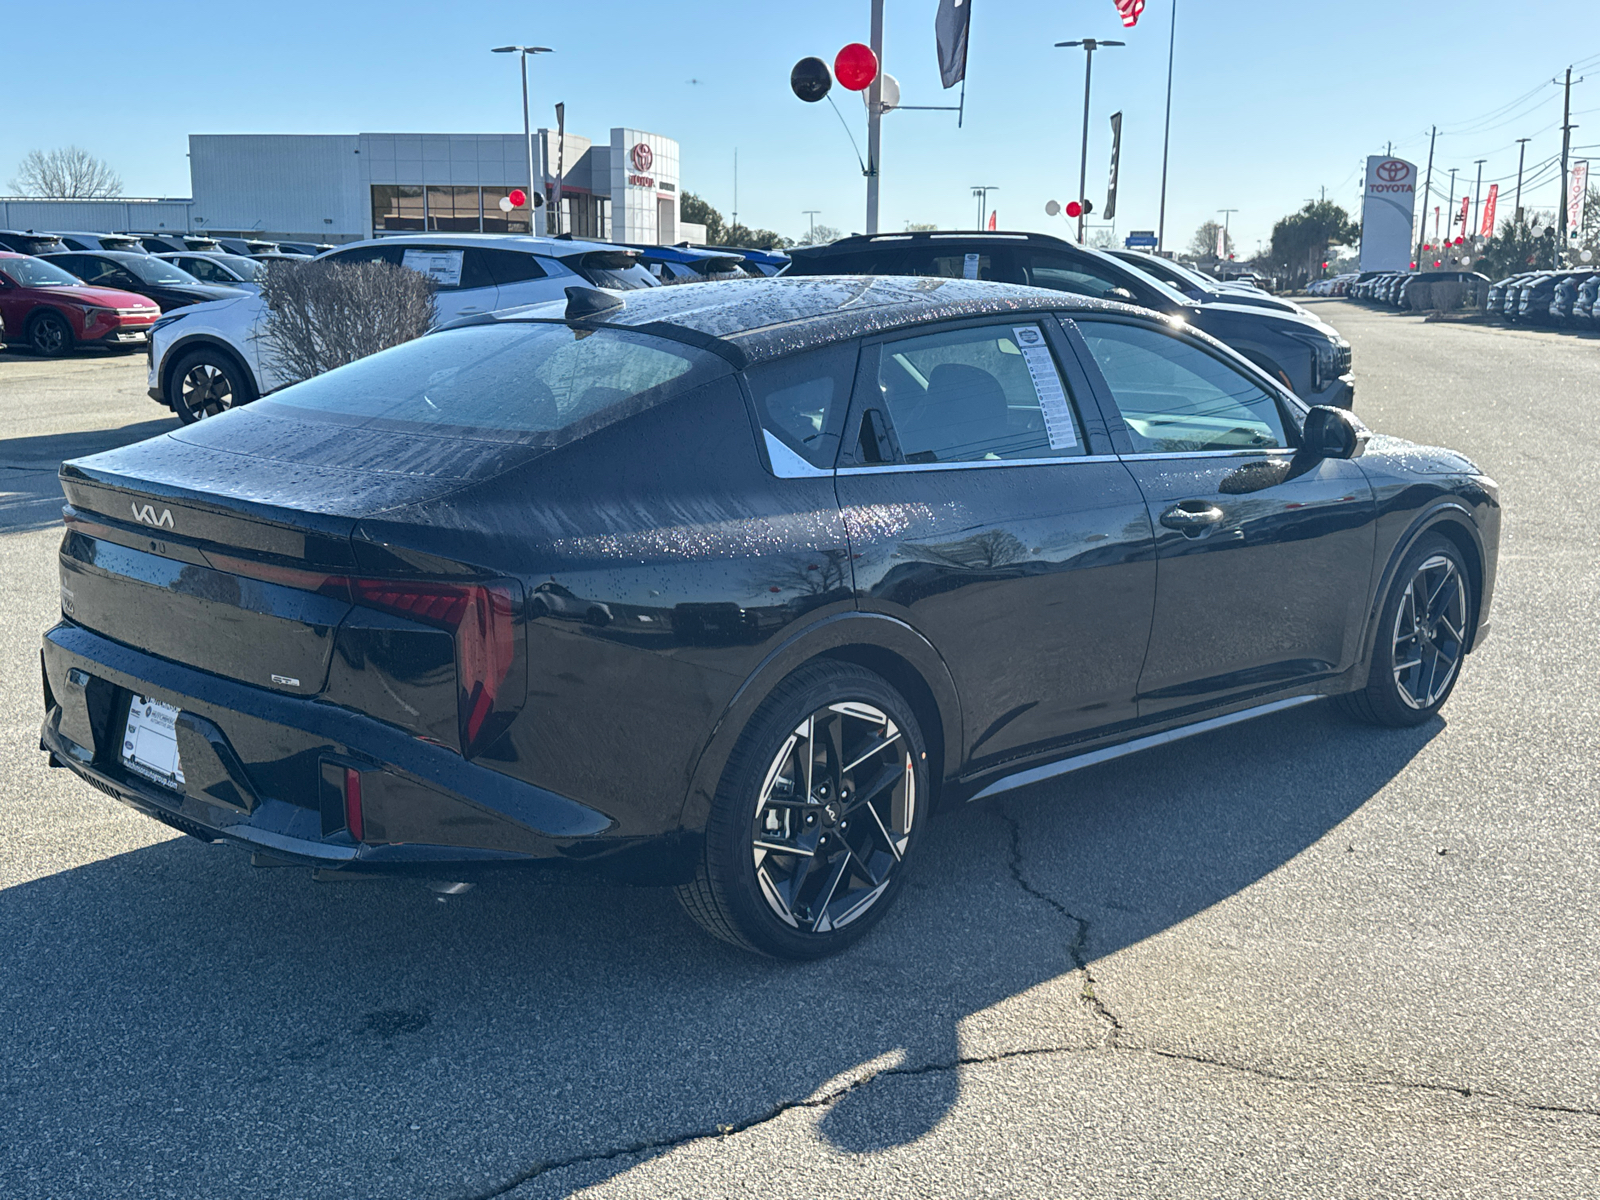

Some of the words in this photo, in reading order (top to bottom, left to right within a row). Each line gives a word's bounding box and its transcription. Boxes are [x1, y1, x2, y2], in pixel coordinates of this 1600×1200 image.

[1369, 184, 1413, 193] TOYOTA
[1570, 177, 1581, 226] TOYOTA
[131, 502, 175, 528] KIA
